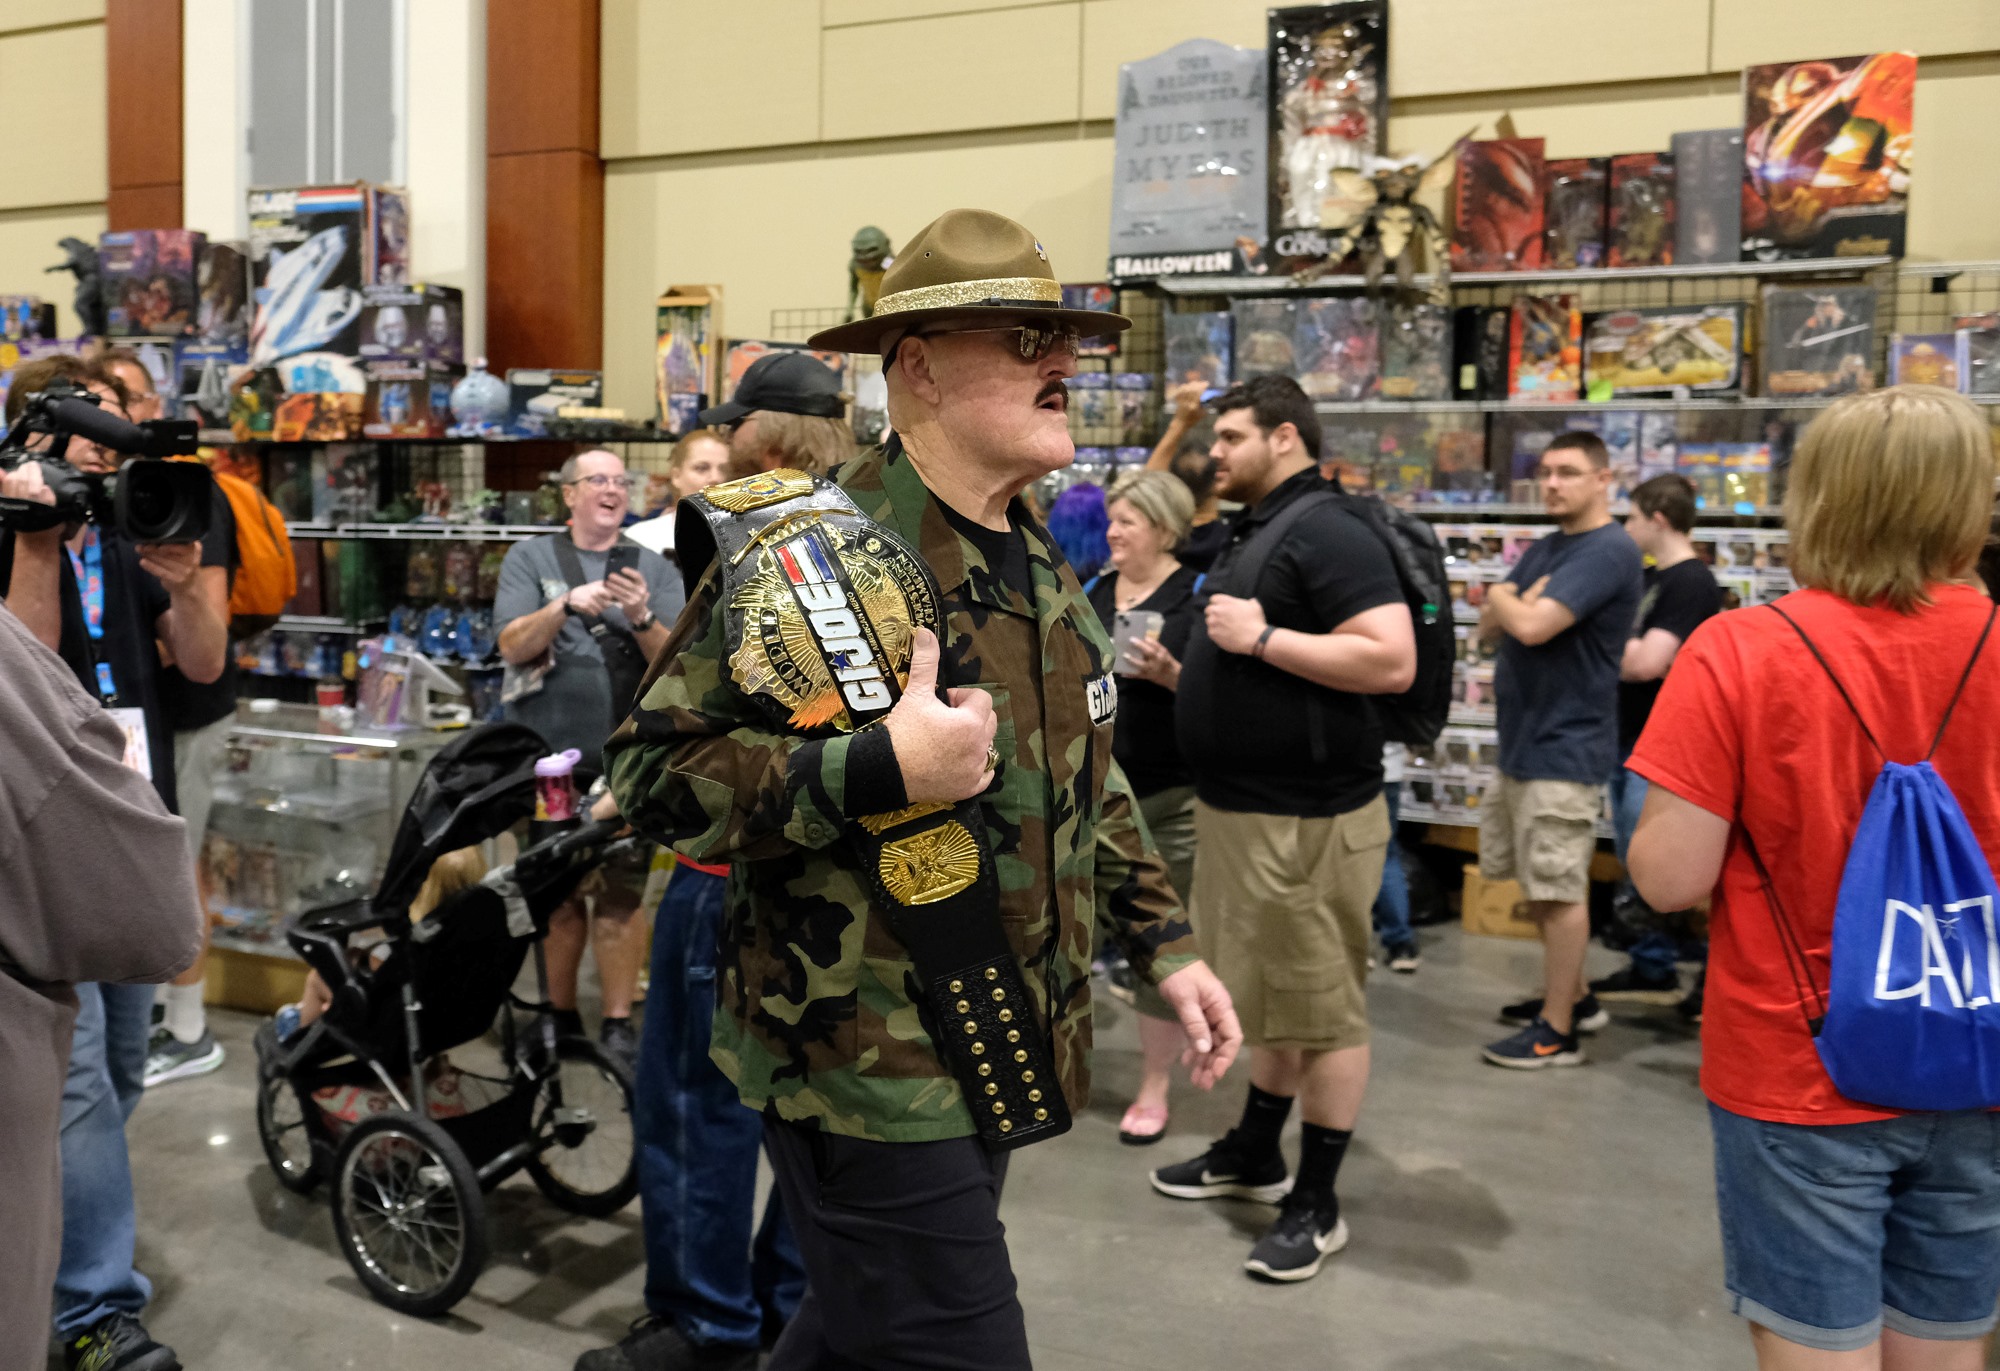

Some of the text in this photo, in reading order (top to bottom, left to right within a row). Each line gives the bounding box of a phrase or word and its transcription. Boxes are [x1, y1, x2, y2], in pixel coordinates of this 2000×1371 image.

[1135, 118, 1250, 148] JUDITH
[1127, 149, 1255, 183] MYERS
[1115, 251, 1232, 276] HALLOWEEN
[846, 591, 862, 612] HERO
[896, 553, 935, 624] CHAMPION
[794, 581, 876, 670] JOE
[857, 612, 880, 653] AMERICAN
[759, 609, 813, 700] WORLD
